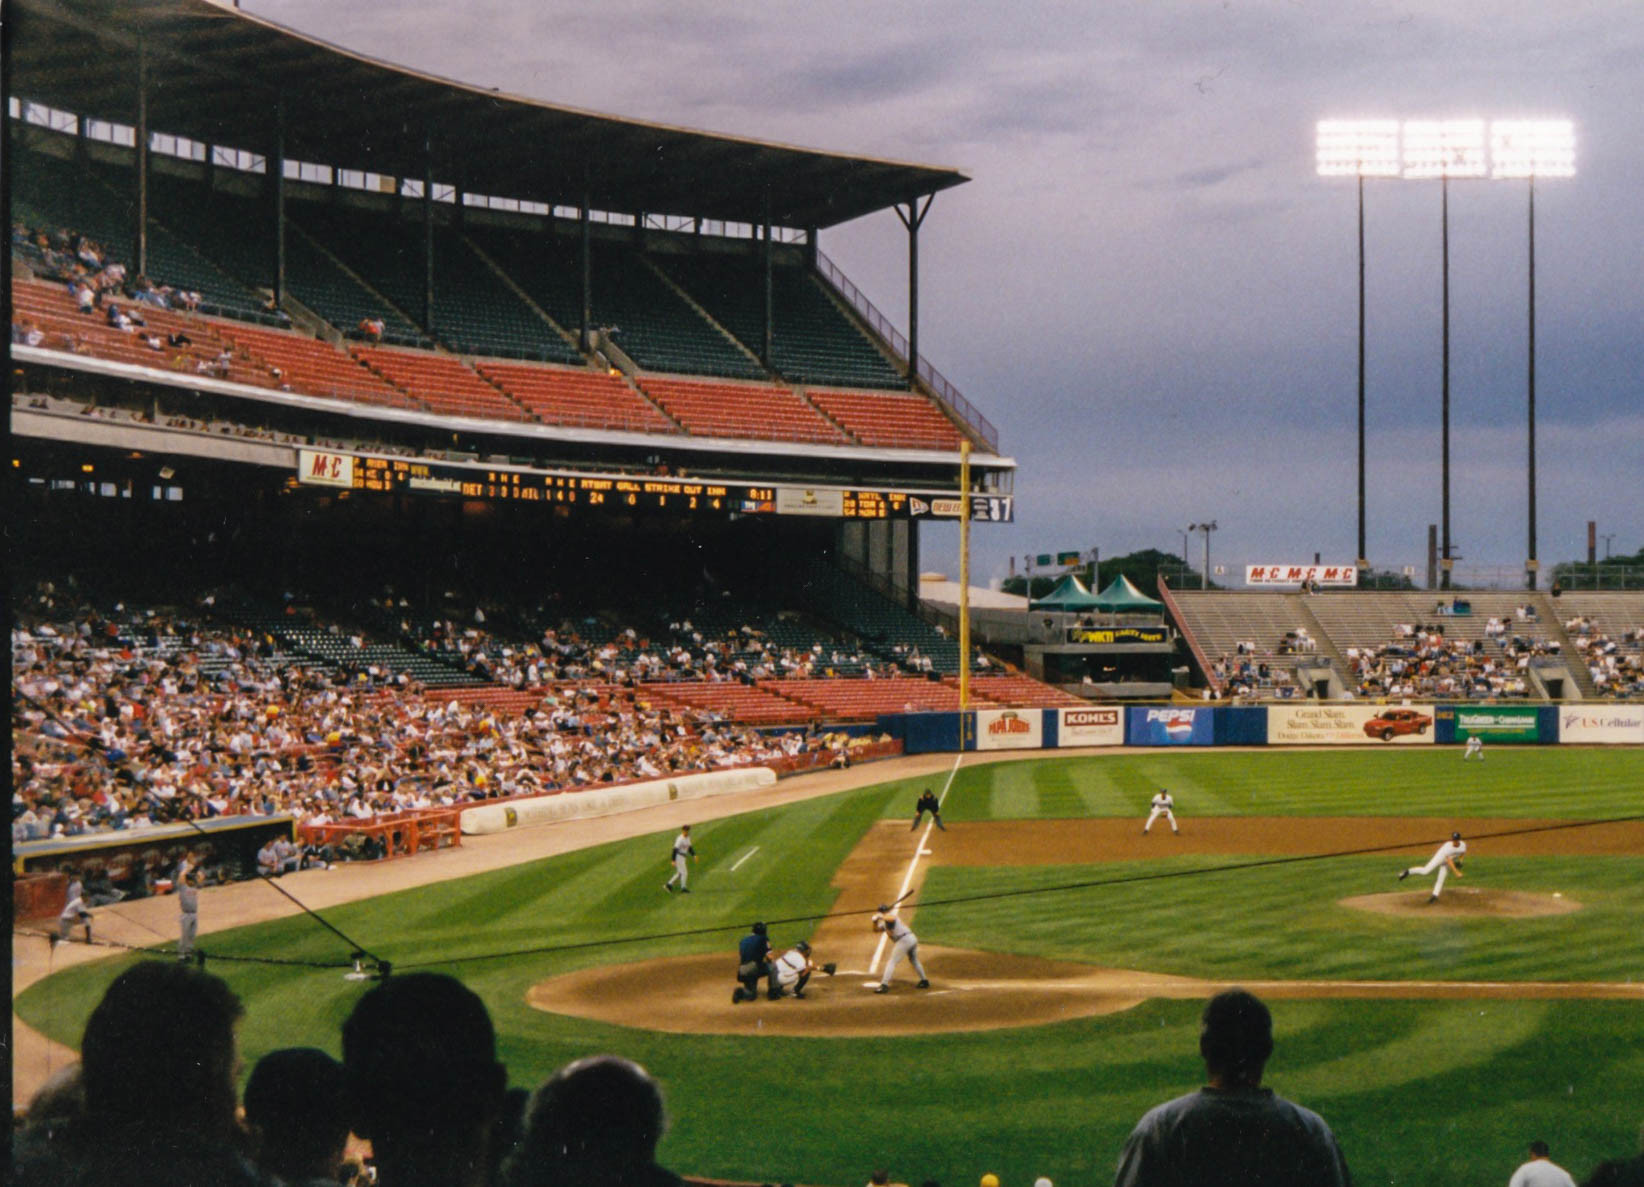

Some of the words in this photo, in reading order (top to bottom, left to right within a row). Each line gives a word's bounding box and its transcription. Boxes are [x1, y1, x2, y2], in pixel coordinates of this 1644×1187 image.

[463, 483, 482, 496] DET
[521, 488, 539, 500] MIL
[590, 491, 604, 504] 24
[644, 482, 681, 493] STRIKE
[683, 485, 702, 494] OUT
[707, 486, 727, 496] INN
[1066, 712, 1116, 724] KOHL'S
[1146, 709, 1196, 722] PEPSI
[1295, 709, 1321, 718] Grand
[988, 720, 1006, 734] PAPA
[1600, 717, 1642, 728] Cellular
